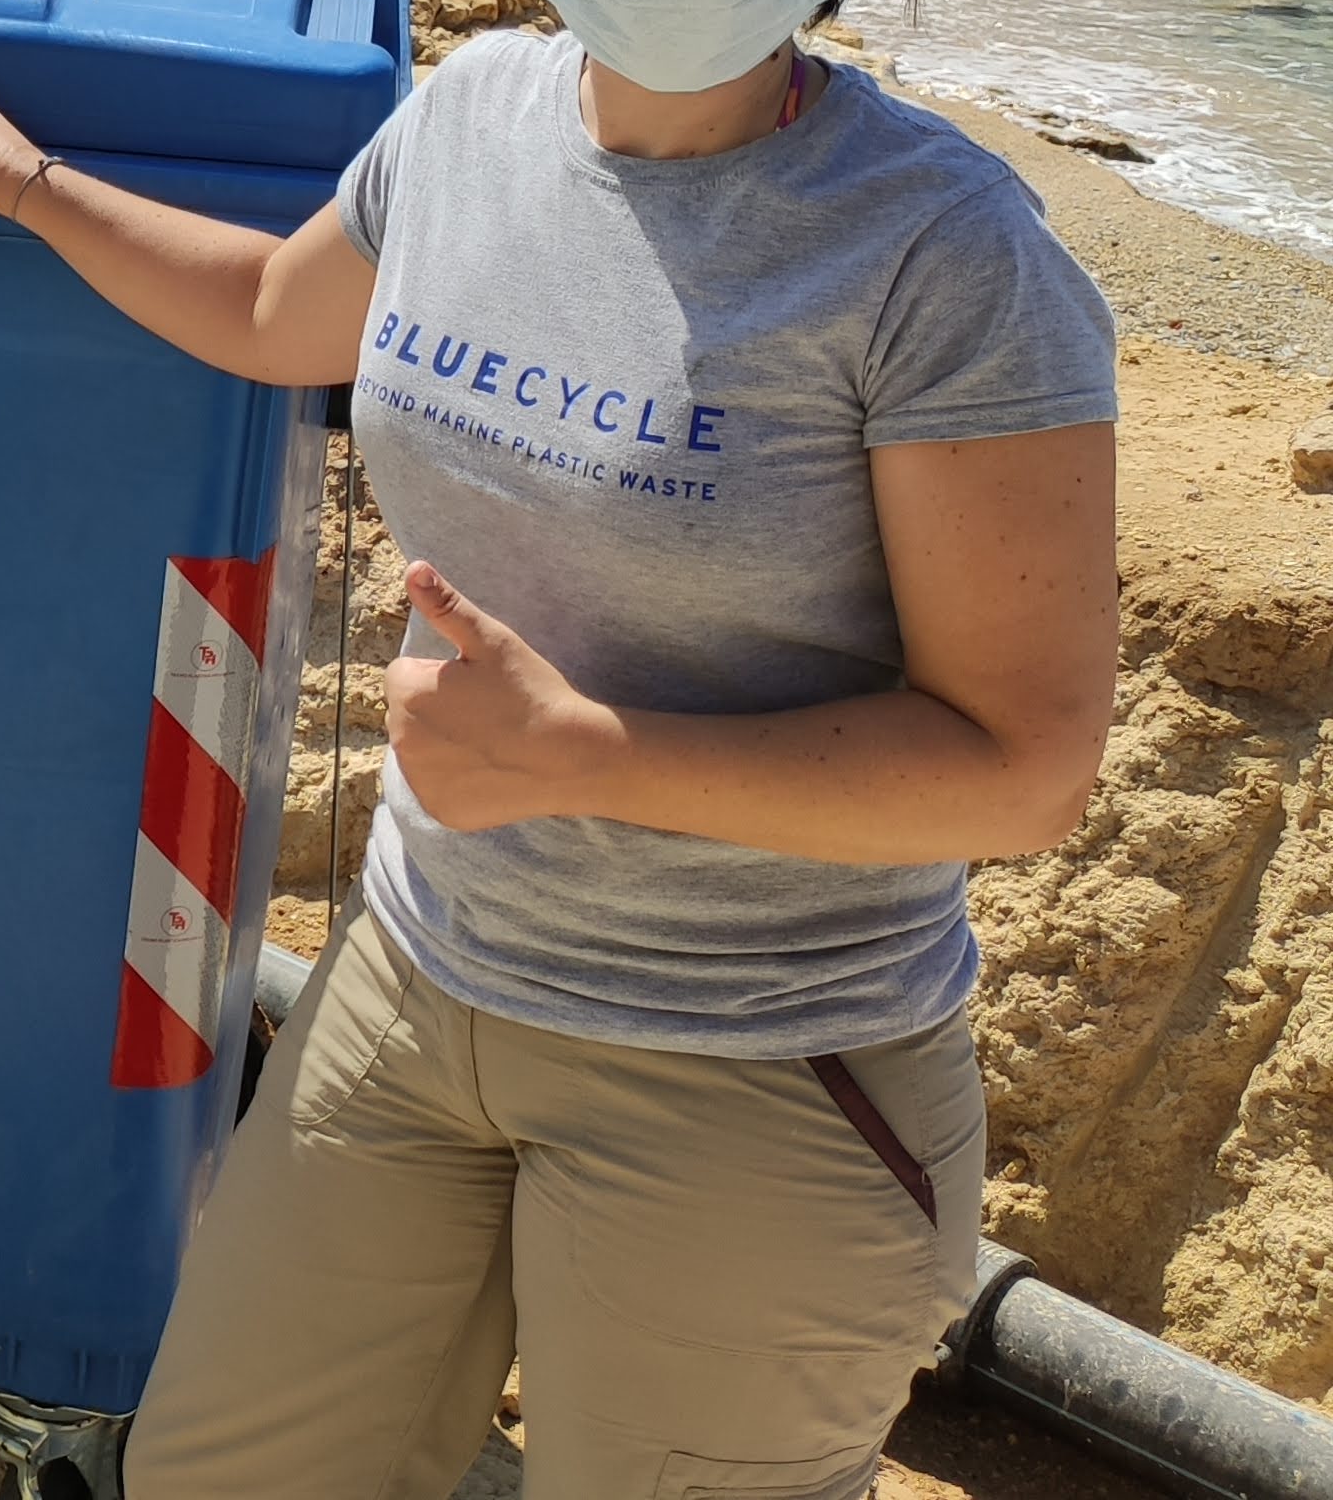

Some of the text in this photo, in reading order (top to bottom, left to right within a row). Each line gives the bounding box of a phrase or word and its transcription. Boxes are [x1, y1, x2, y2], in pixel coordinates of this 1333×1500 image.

[357, 373, 716, 501] BEYOND MARINE PLASTIC WASTE
[374, 311, 725, 452] BLUECYCLE
